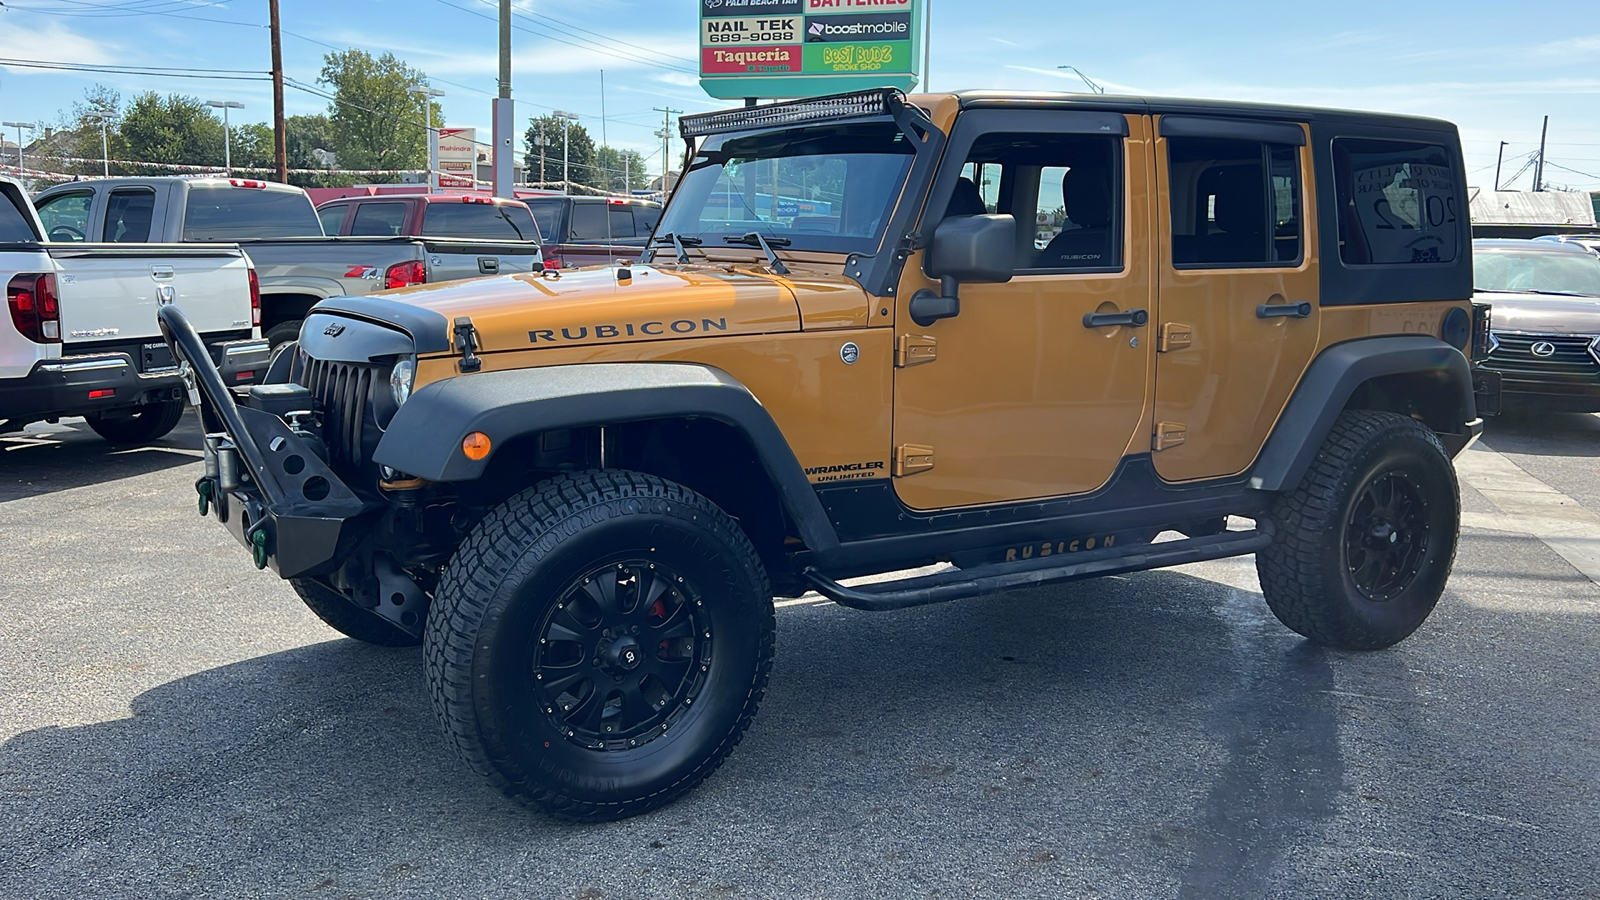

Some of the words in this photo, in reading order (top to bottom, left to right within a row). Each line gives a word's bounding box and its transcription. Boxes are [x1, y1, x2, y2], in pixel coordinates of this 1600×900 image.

[708, 21, 749, 32] NAIL
[756, 19, 795, 31] TEK
[710, 32, 793, 43] 689-9088
[856, 45, 893, 63] BUDZ
[833, 63, 859, 71] SMOKE
[860, 62, 881, 70] SHOP
[528, 317, 727, 343] RUBICON
[804, 461, 884, 475] WRANGLER
[817, 471, 875, 482] UNLIMITED
[1005, 535, 1115, 562] RUBICON
